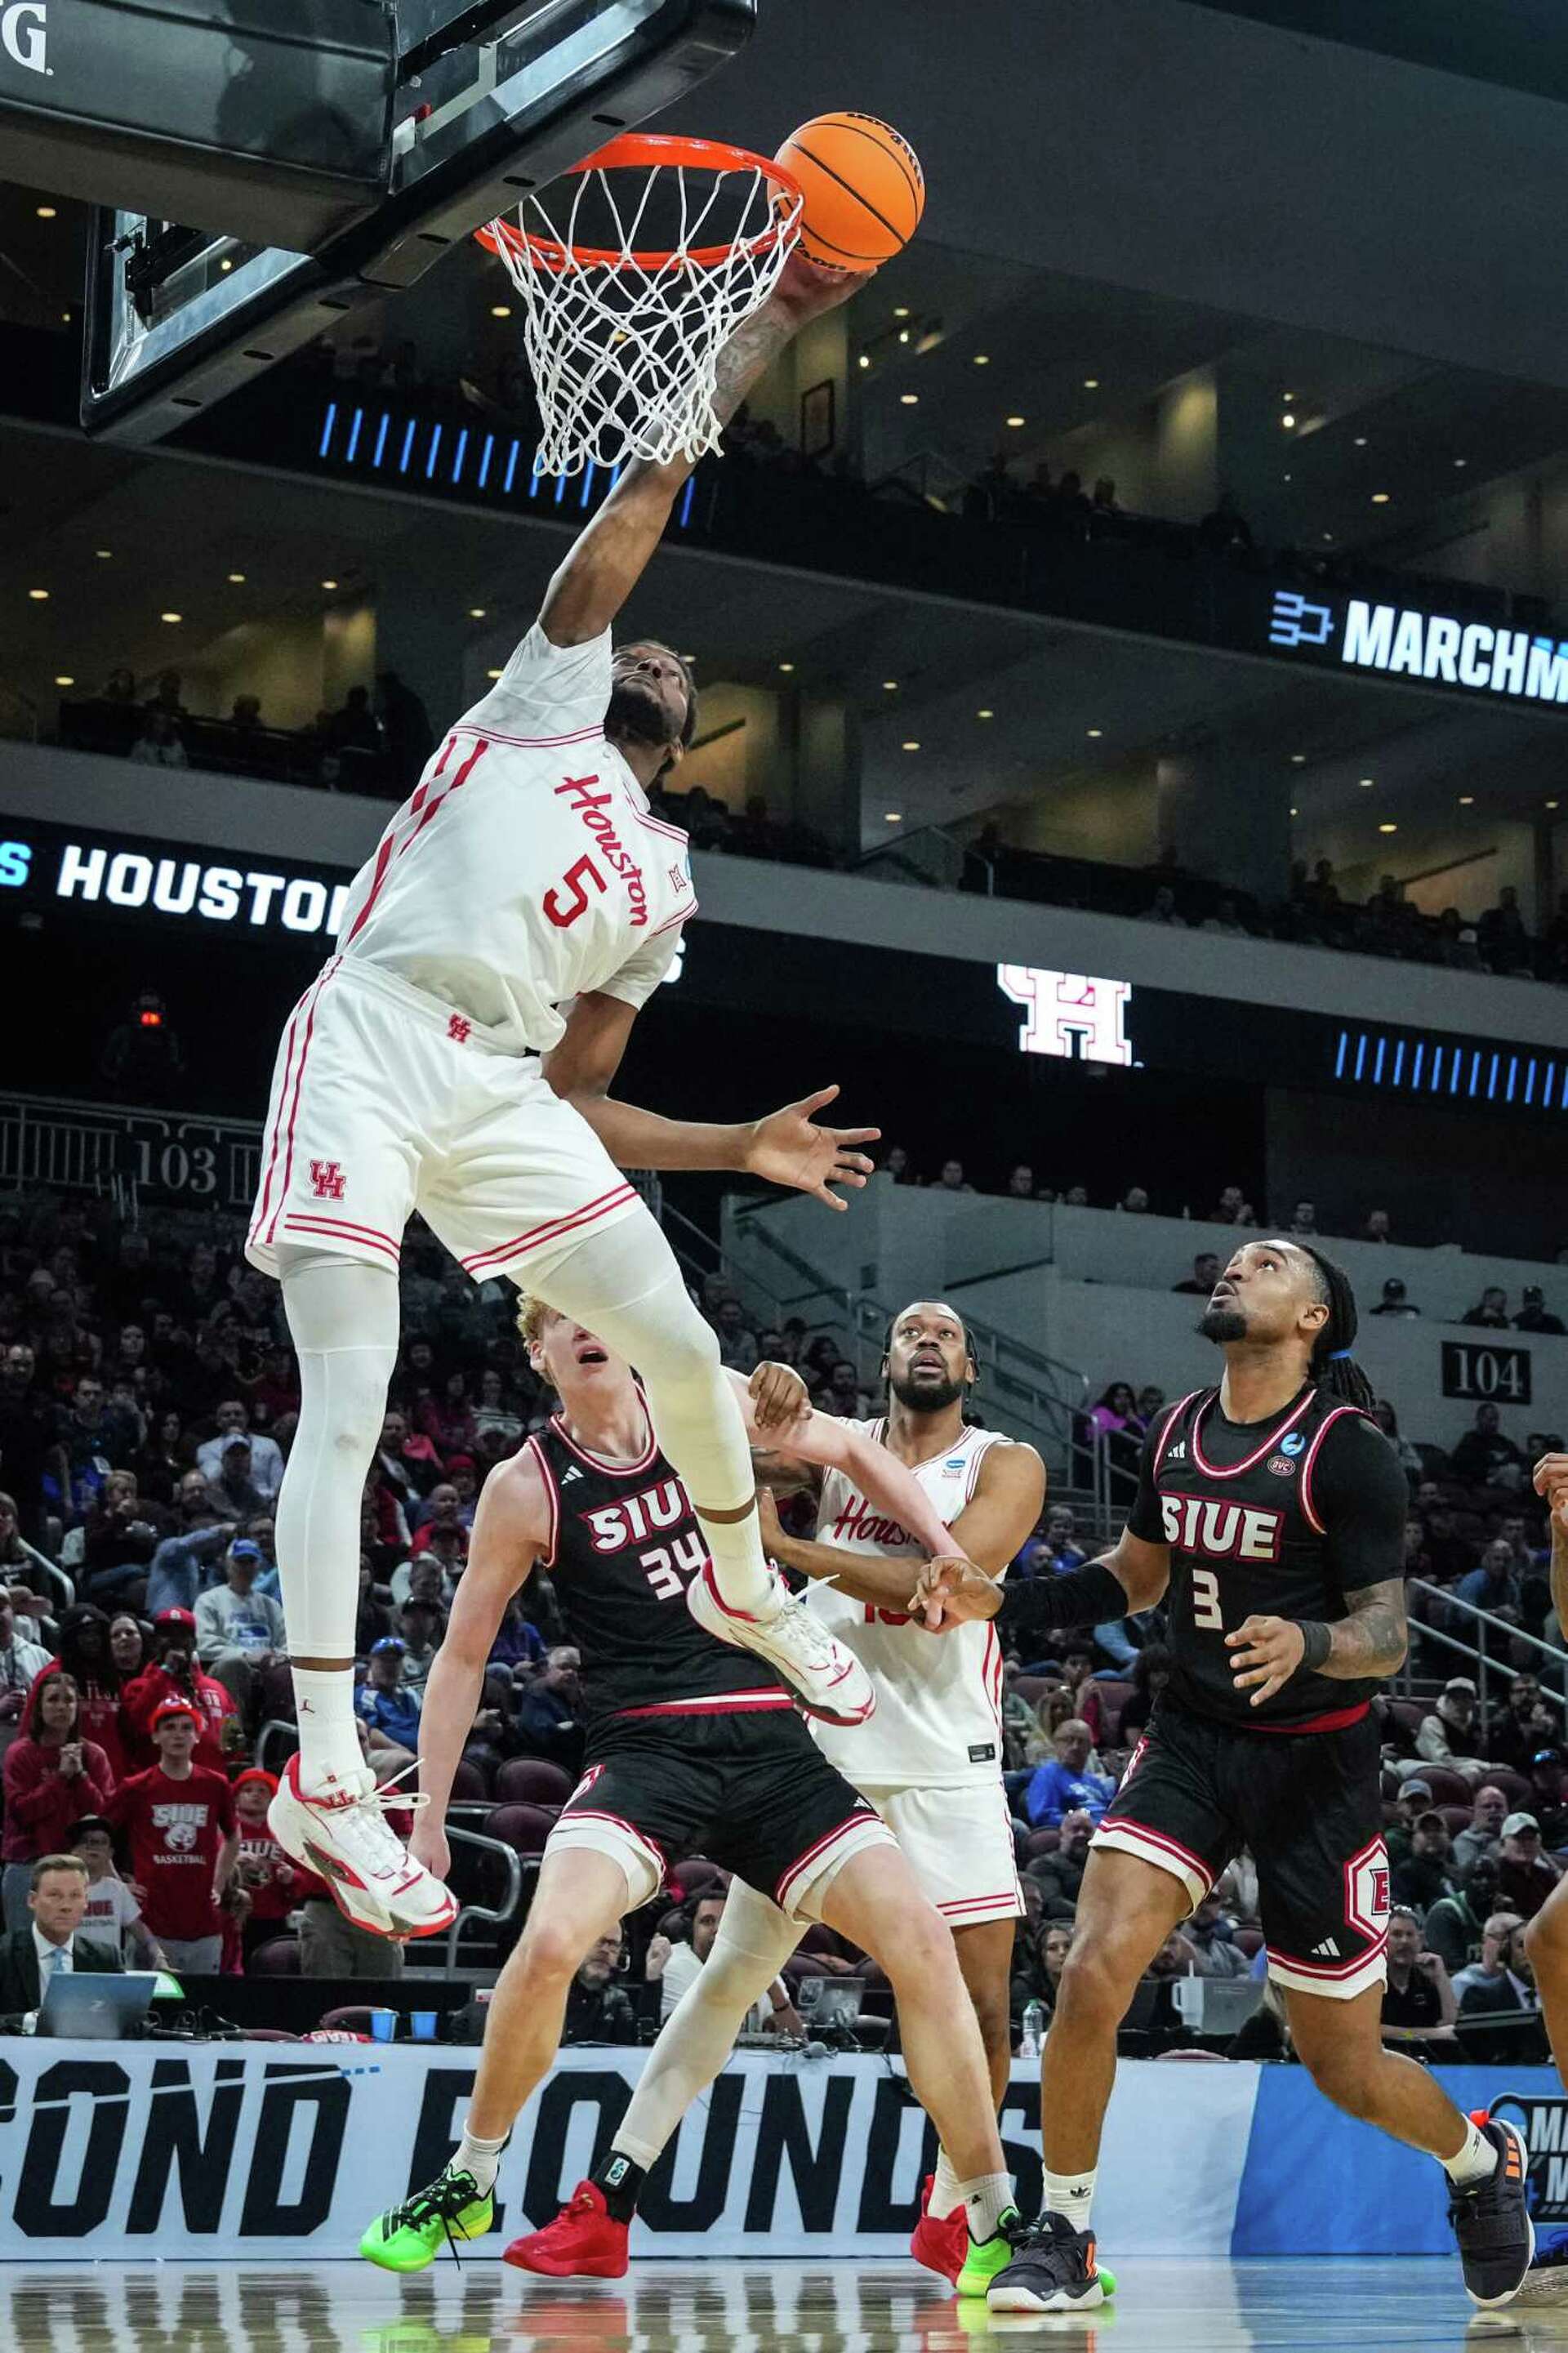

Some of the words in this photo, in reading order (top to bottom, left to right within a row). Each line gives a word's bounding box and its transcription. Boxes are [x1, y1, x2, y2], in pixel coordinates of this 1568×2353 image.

[554, 773, 648, 926] Houston
[542, 853, 608, 928] 5
[135, 1140, 217, 1193] 103
[1454, 1349, 1525, 1397] 104
[584, 1478, 696, 1551] SIU
[833, 1494, 920, 1546] Hous
[1161, 1495, 1279, 1559] SIUE
[639, 1530, 709, 1601] 34
[1192, 1568, 1223, 1630] 3
[151, 1803, 210, 1828] SIUE
[0, 2058, 352, 2238] OND
